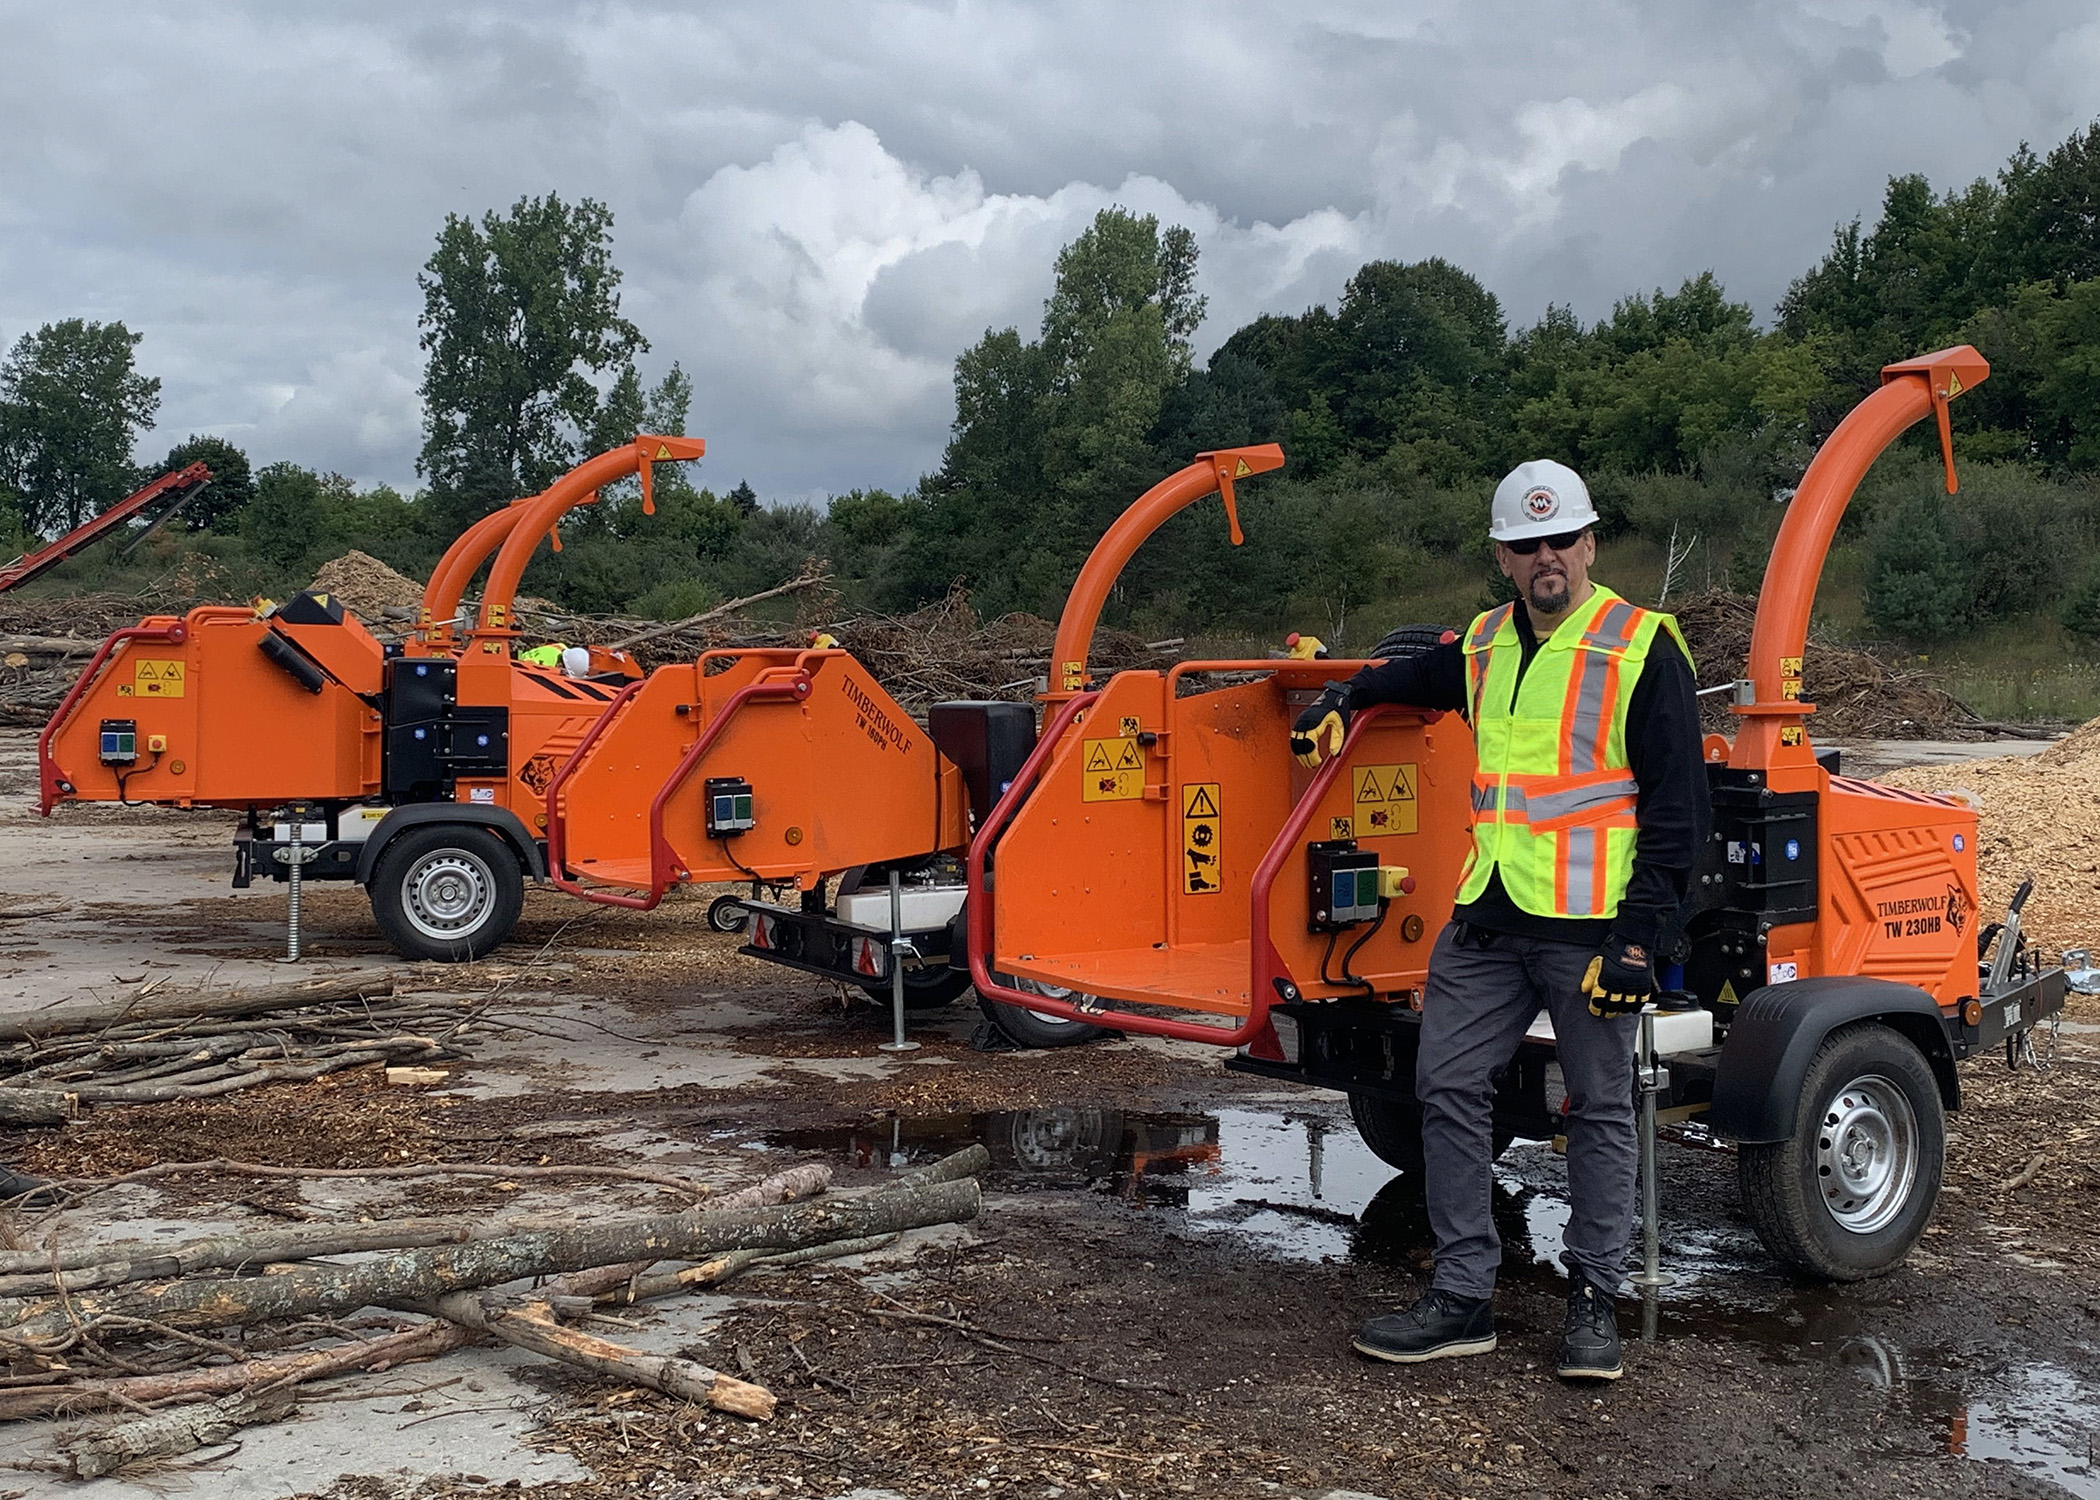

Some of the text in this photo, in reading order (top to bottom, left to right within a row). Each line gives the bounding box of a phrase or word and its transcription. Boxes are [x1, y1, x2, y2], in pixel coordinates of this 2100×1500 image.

[841, 674, 913, 755] TIMBERWOLF
[855, 712, 868, 730] TW
[1876, 895, 1947, 918] TIMBERWOLF
[1884, 916, 1942, 940] TW 230HB
